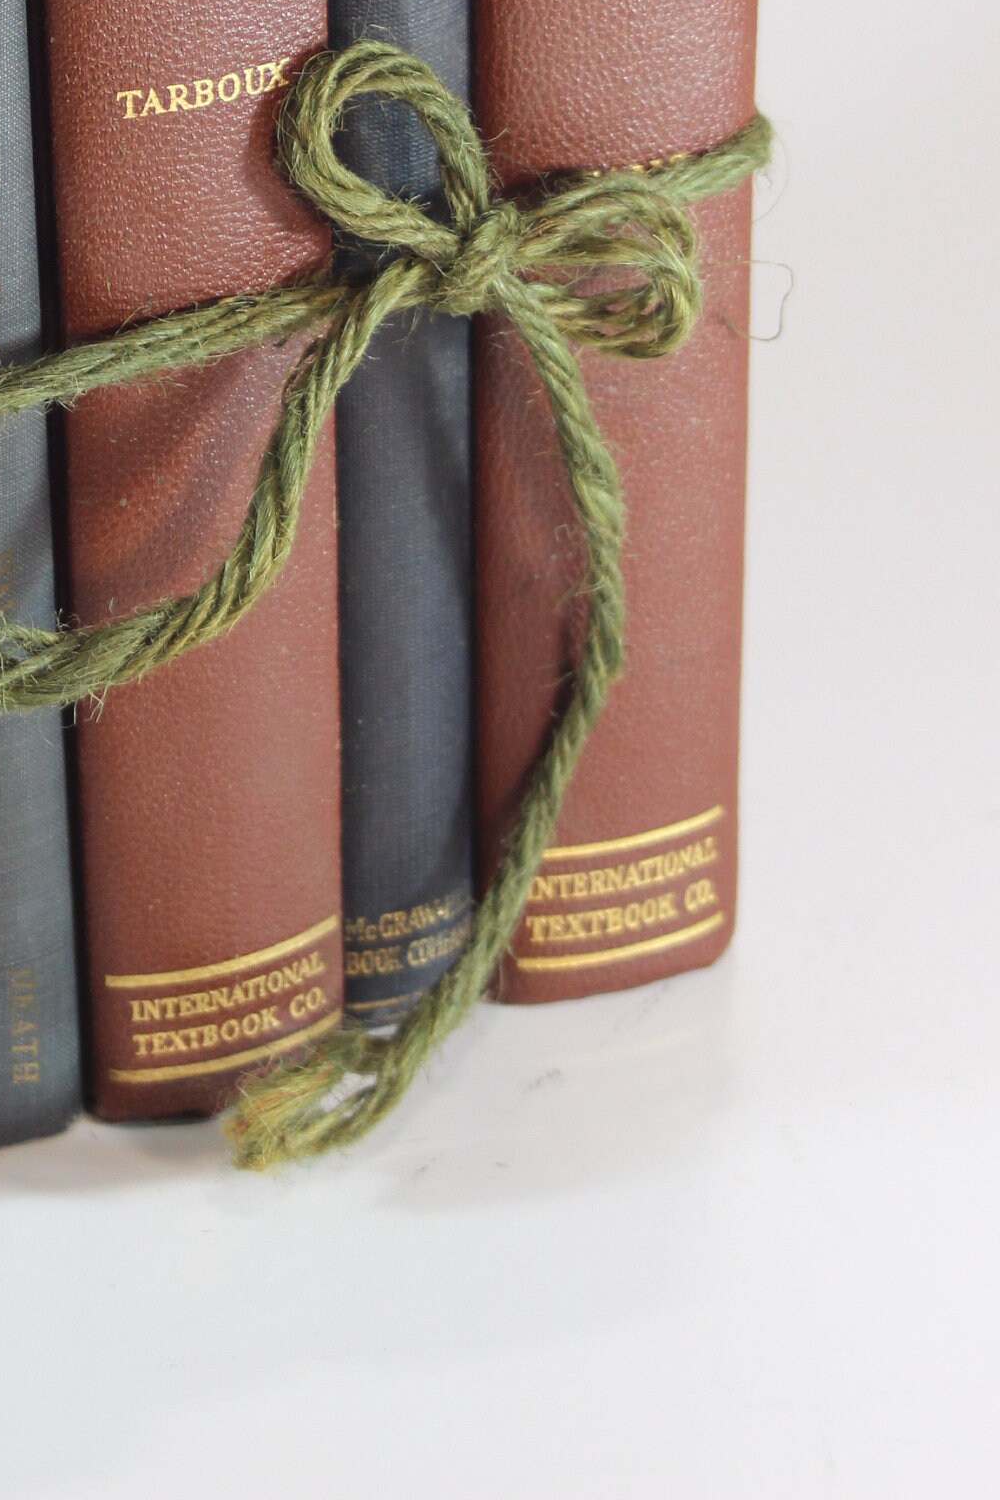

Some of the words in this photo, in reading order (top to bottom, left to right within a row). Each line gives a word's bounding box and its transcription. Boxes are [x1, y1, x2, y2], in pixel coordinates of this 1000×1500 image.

[115, 56, 291, 120] TARBOUX
[527, 835, 718, 902] INTERNATIONAL
[525, 892, 679, 943] TEXTBOOK
[130, 950, 325, 1023] INTERNATIONAL
[132, 1005, 281, 1056] TEXTBOOK
[289, 985, 327, 1020] CO.
